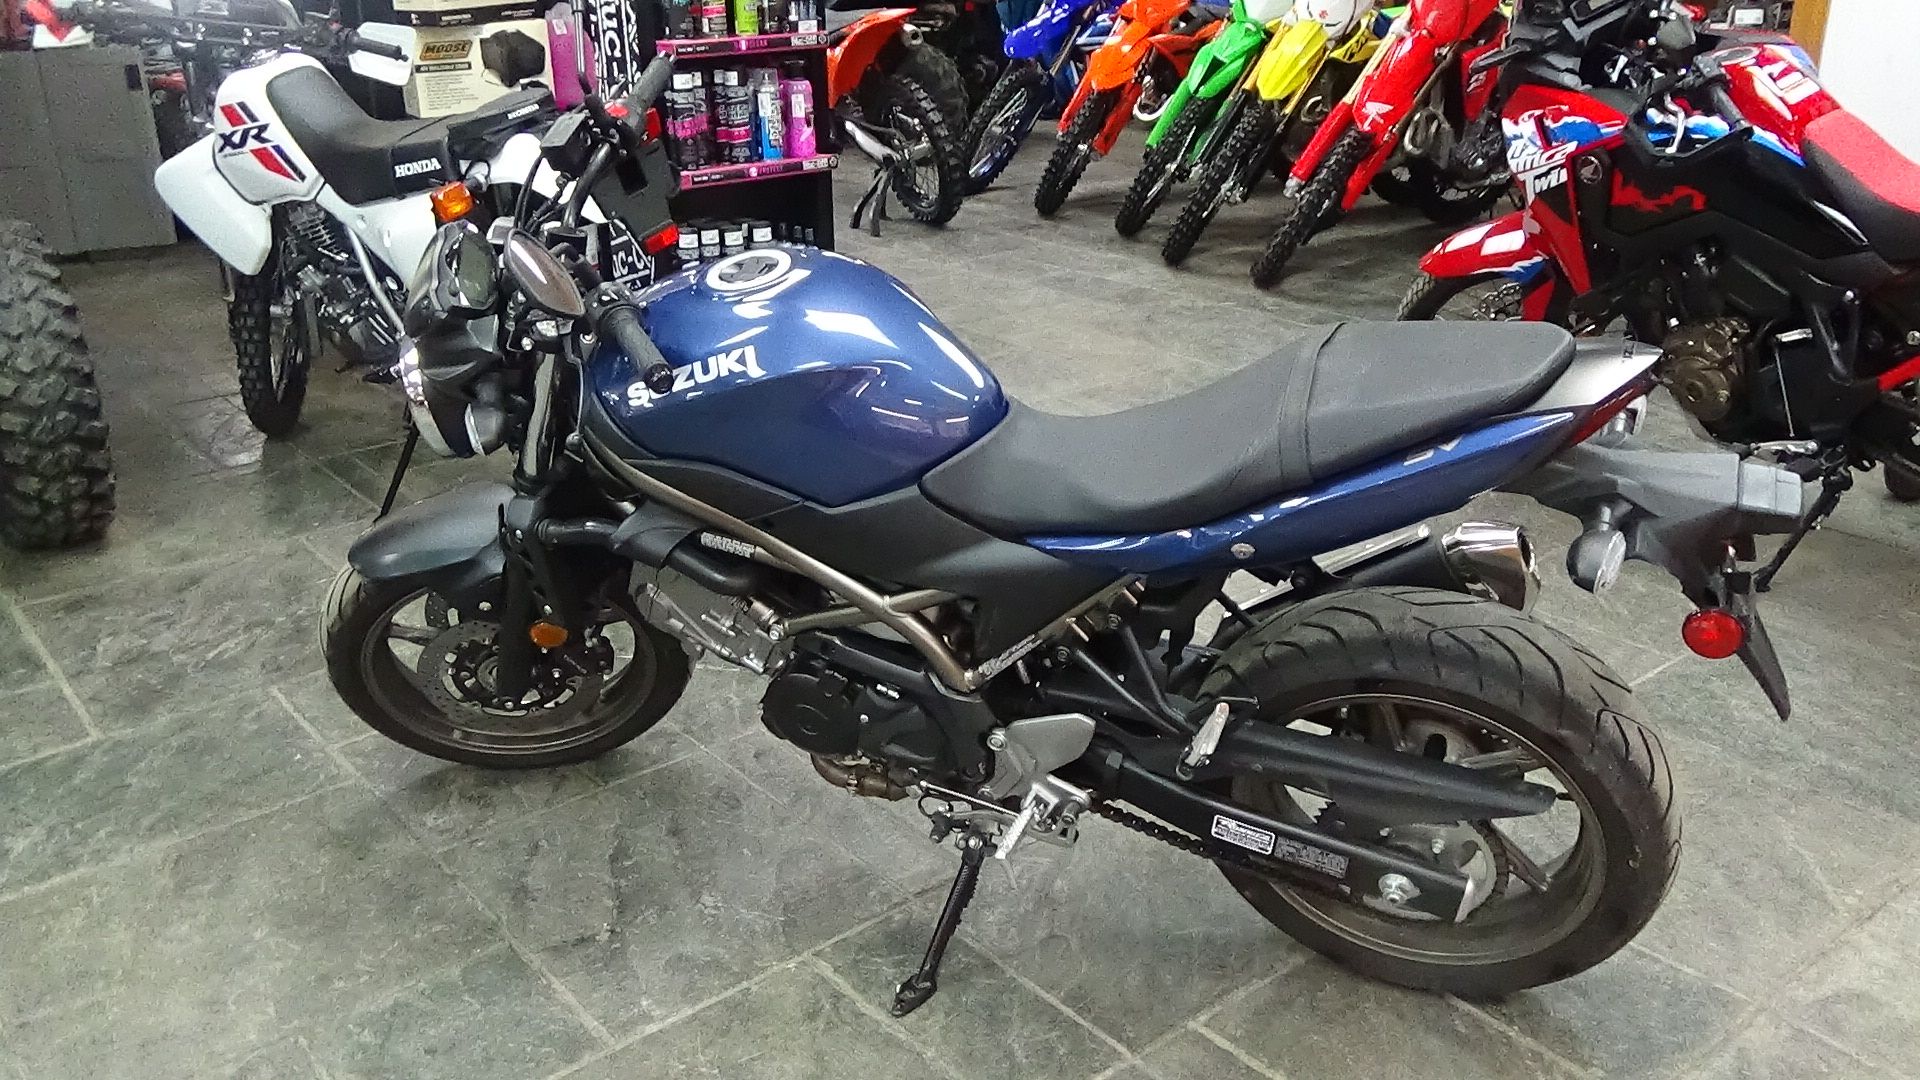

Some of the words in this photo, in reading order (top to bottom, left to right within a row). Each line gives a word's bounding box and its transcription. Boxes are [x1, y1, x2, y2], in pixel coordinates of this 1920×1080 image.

[424, 40, 469, 55] MOOSE
[217, 123, 274, 154] XR
[394, 157, 442, 178] HONDA
[626, 345, 768, 408] SZUKI
